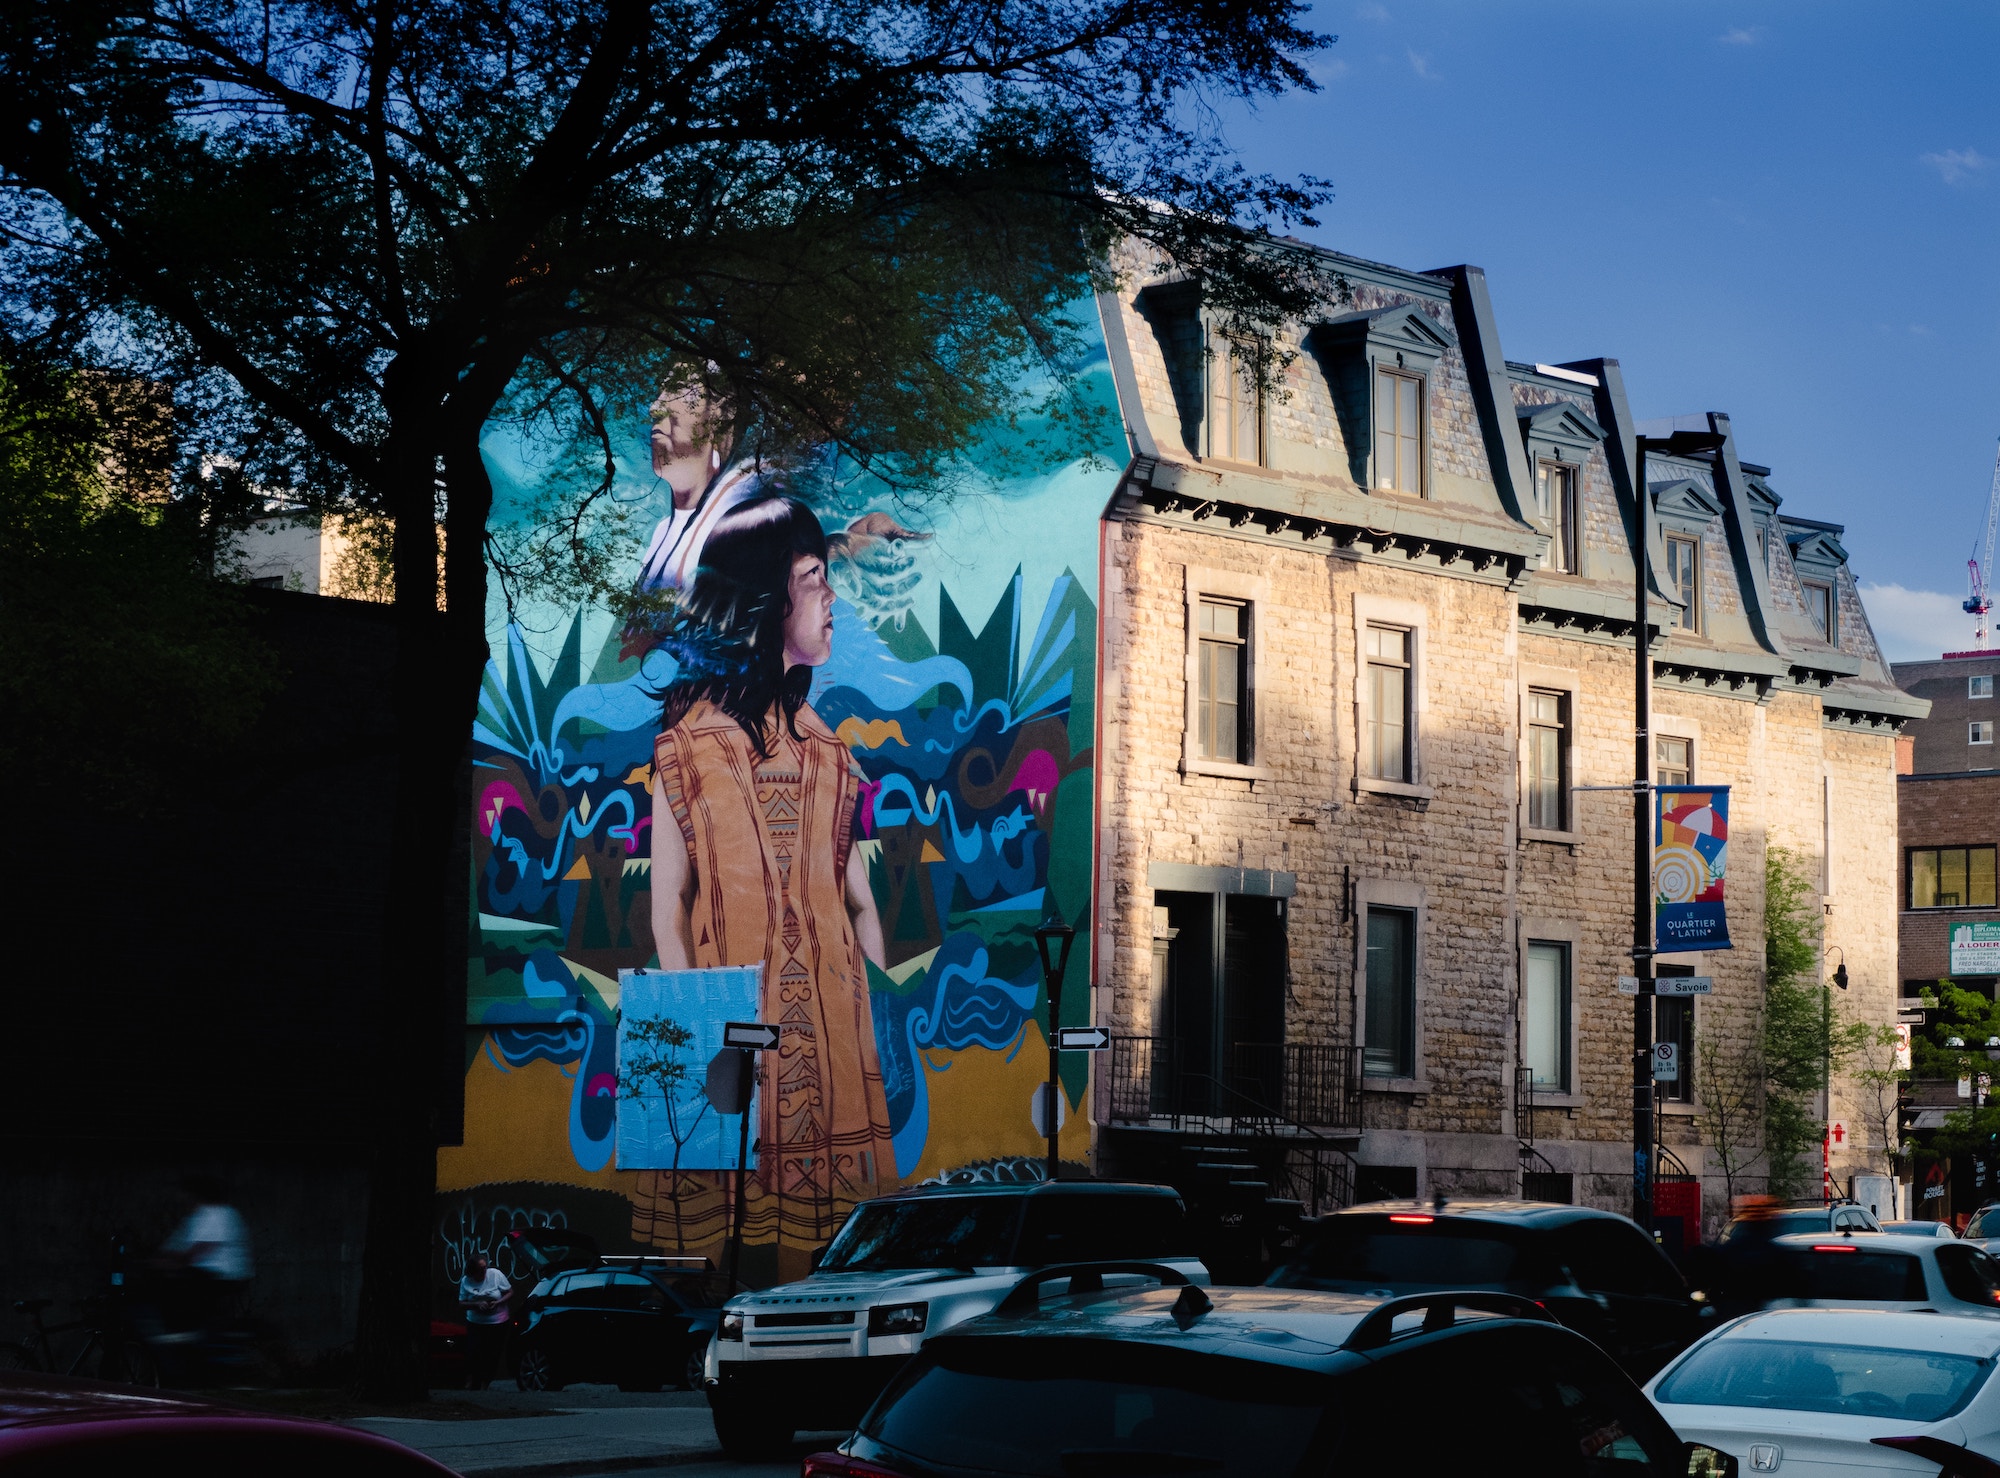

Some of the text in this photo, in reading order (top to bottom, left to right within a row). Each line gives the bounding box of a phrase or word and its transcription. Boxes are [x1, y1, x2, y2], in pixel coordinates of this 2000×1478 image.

[1667, 919, 1716, 930] QUARTIER
[1678, 929, 1707, 937] LATIN
[1675, 982, 1708, 992] Savoie
[1926, 1185, 1944, 1193] POULET
[1924, 1190, 1944, 1199] ROUGE
[760, 1296, 855, 1304] DEFENDER
